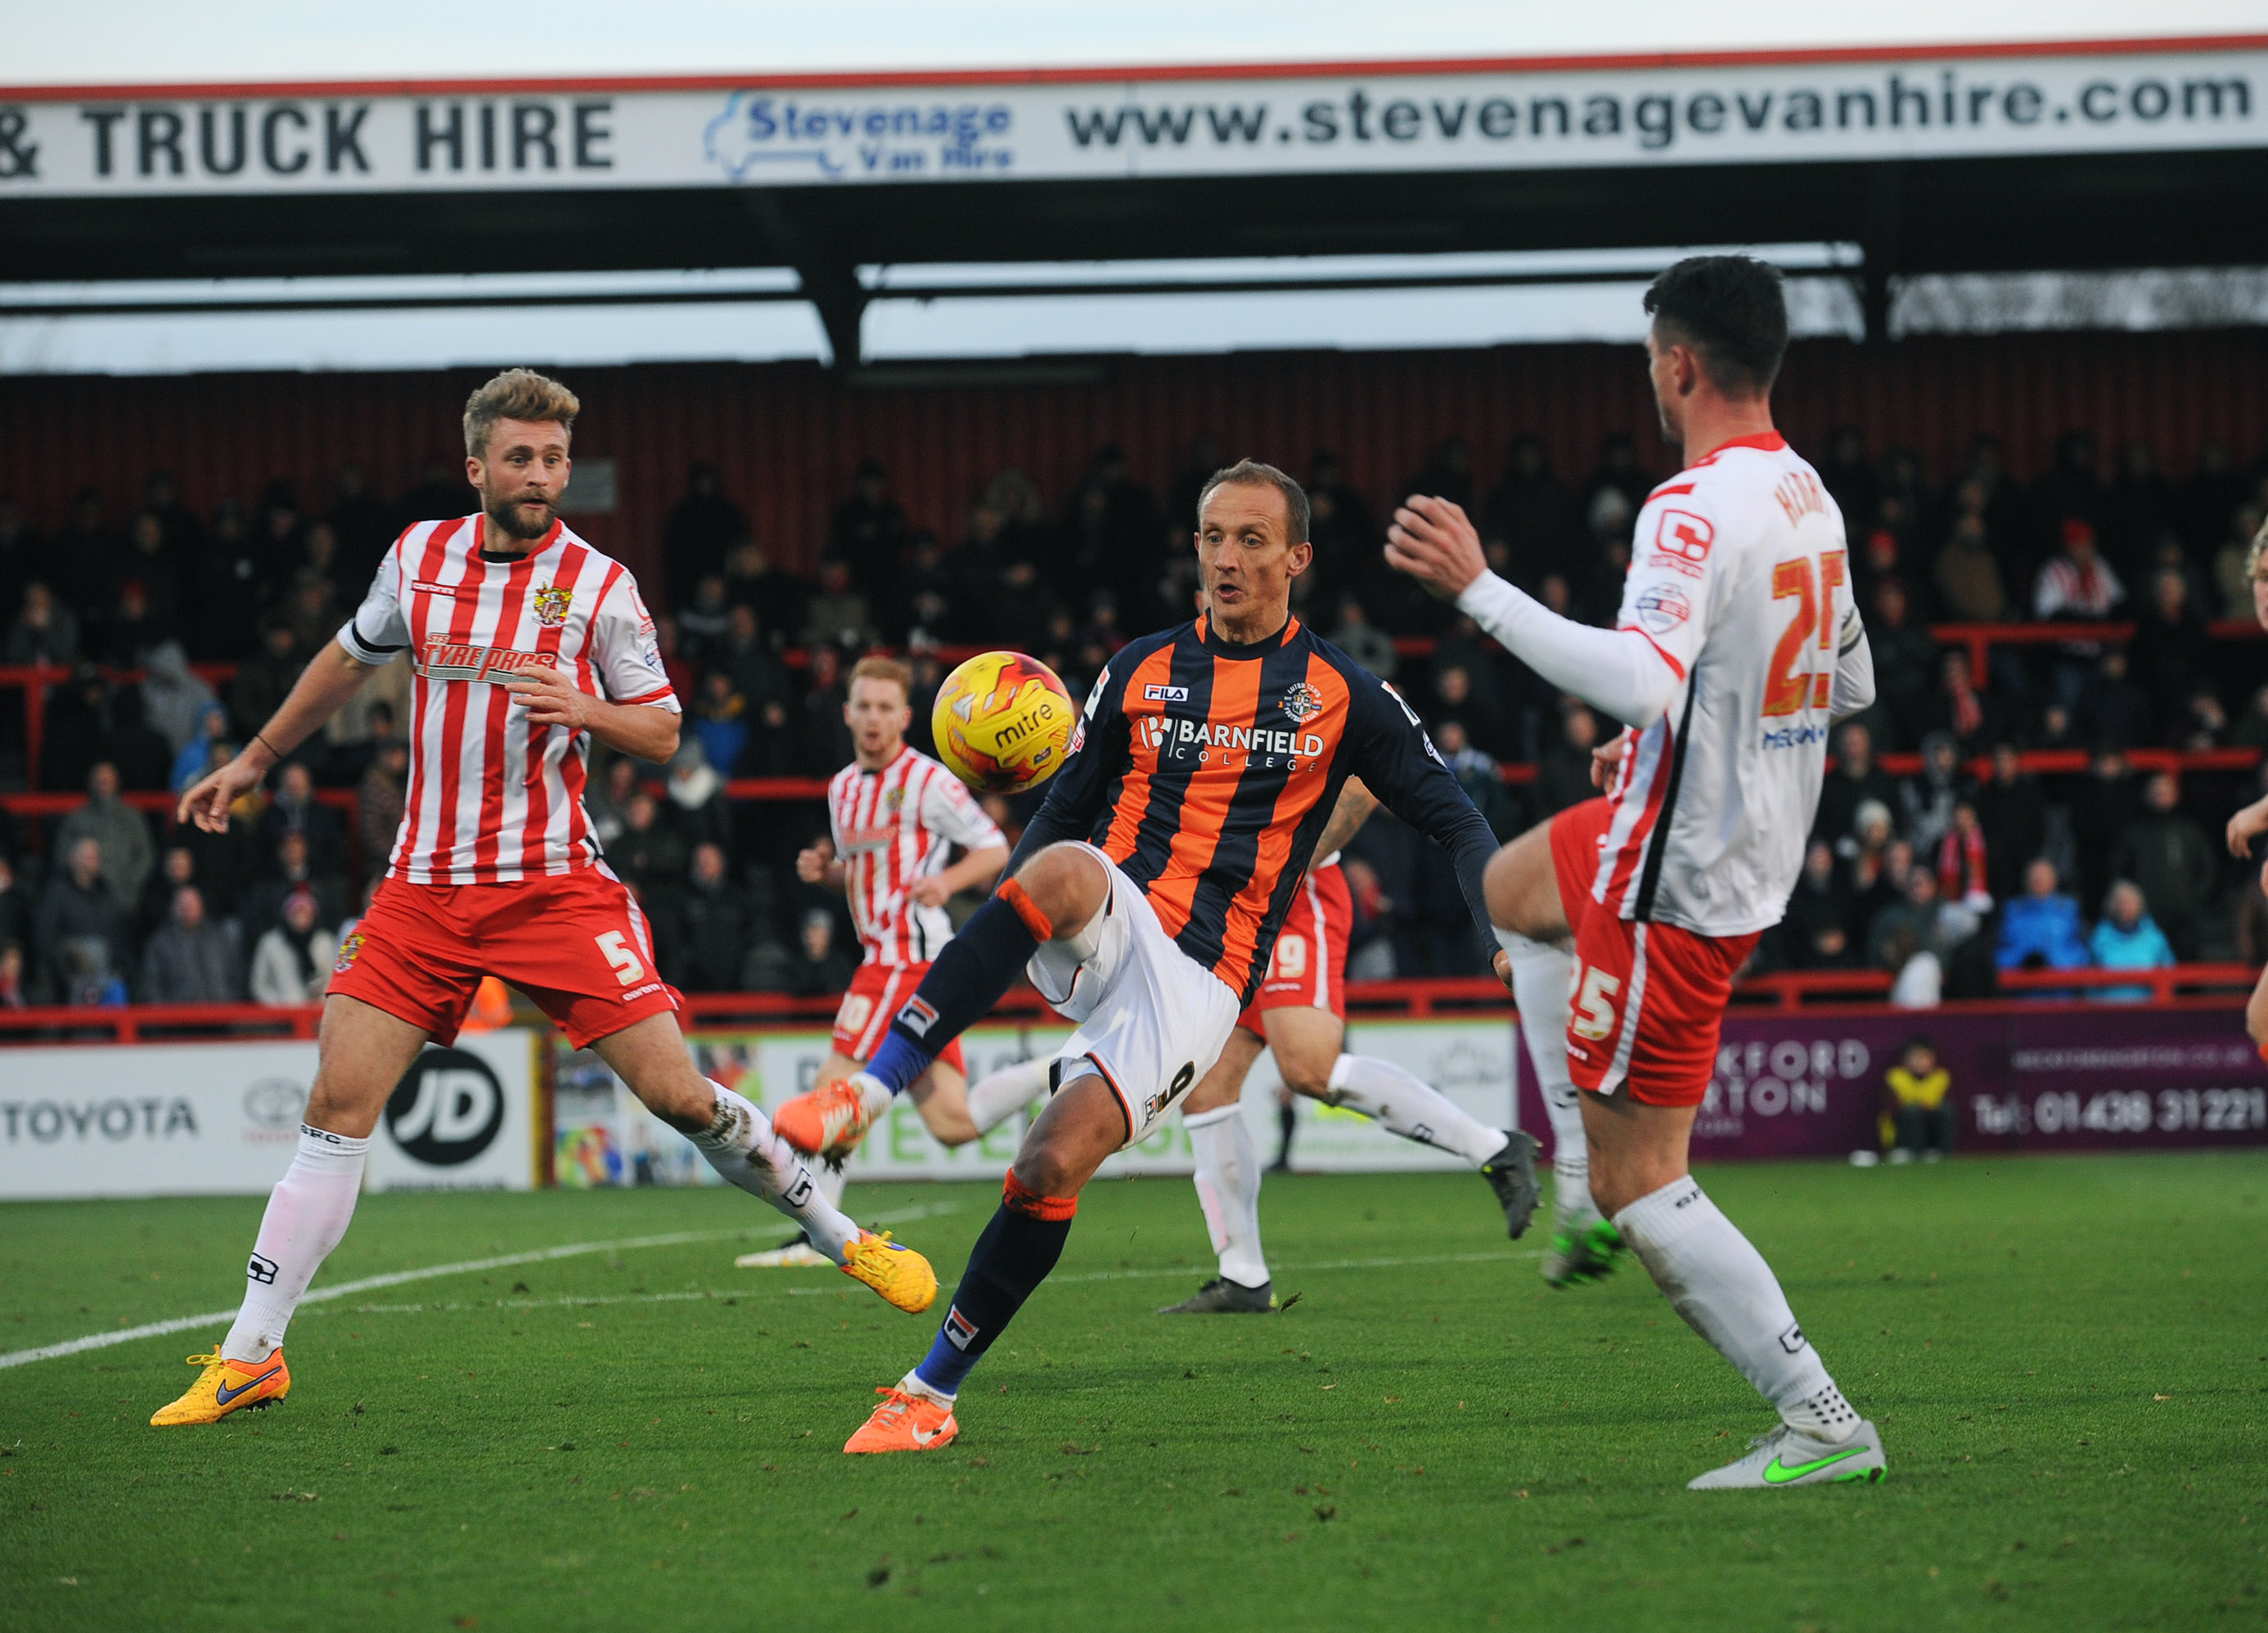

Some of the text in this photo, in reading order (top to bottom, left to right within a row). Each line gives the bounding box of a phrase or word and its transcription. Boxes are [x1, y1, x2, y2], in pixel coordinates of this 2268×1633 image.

[748, 97, 1013, 155] Stevenage
[1065, 70, 2253, 151] www.stevenagevanhire.com
[0, 101, 614, 177] & TRUCK HIRE
[422, 643, 484, 676] TYRE
[1148, 686, 1184, 700] FILA
[994, 703, 1054, 749] mitre
[1178, 718, 1324, 757] BARNFIELD
[1175, 747, 1317, 772] COLLEGE
[594, 929, 645, 987] 5
[393, 1067, 497, 1144] JD
[1156, 1060, 1195, 1113] 9
[2, 1097, 200, 1145] TOYOTA
[300, 1124, 341, 1145] SFC
